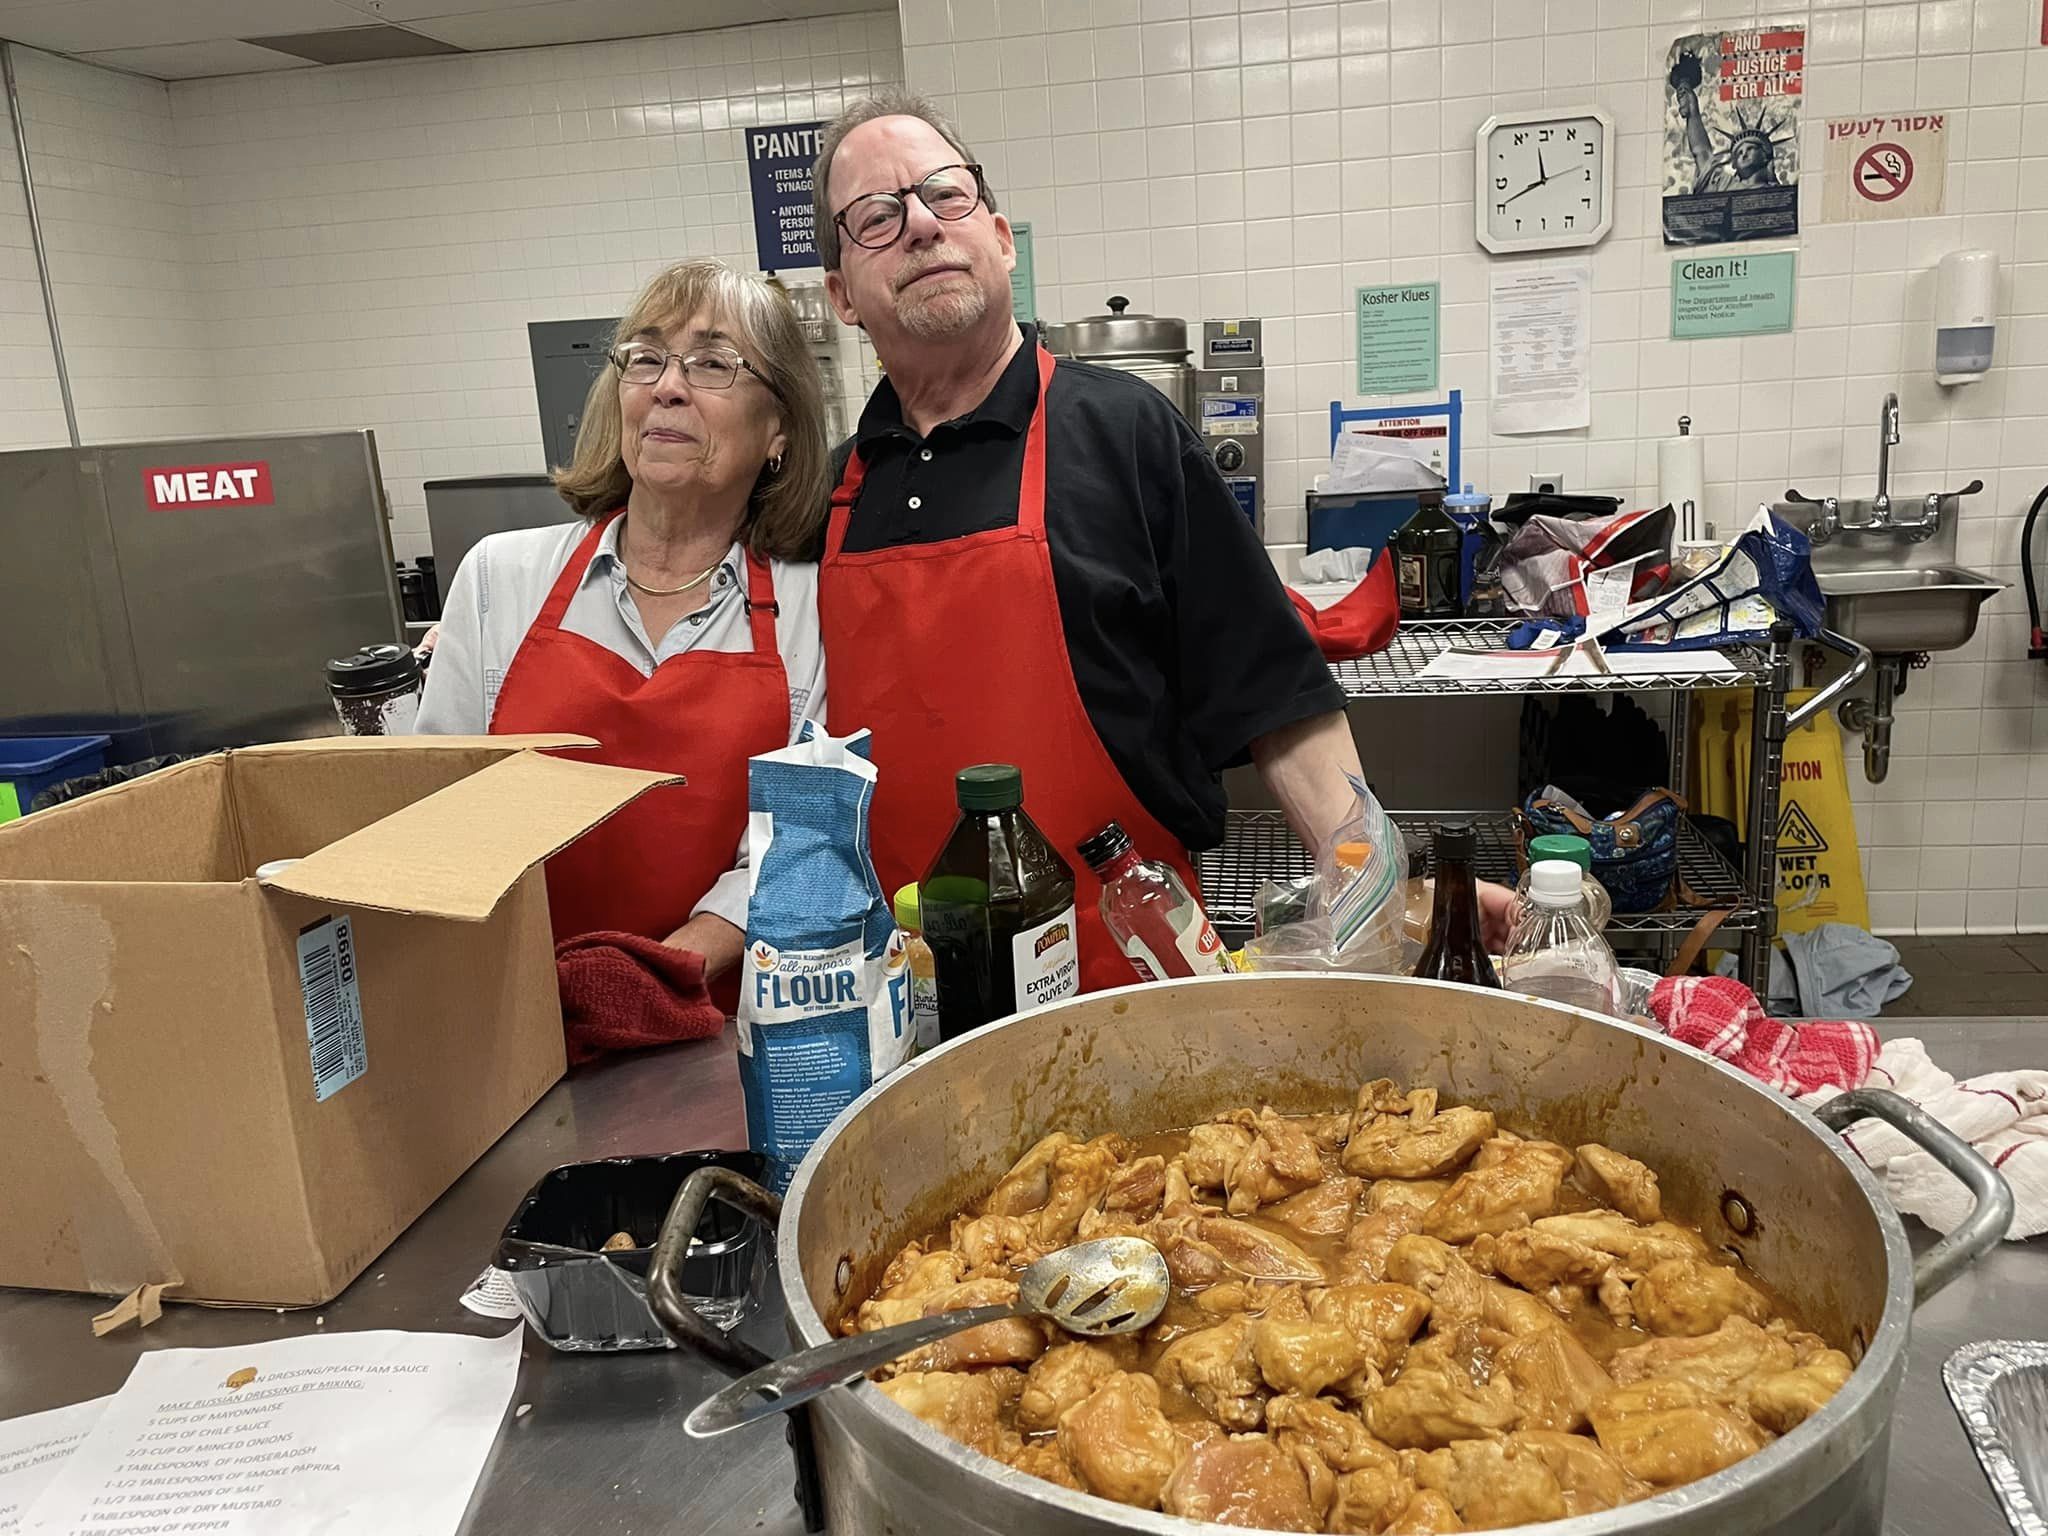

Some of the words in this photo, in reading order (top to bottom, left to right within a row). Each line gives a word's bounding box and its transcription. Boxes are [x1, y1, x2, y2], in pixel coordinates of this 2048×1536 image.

[1733, 56, 1787, 75] JUSTICE
[1733, 82, 1758, 99] FOR
[1566, 128, 1577, 141] א
[775, 168, 803, 180] ITEMS
[776, 180, 814, 193] SYNAGO
[779, 204, 816, 217] ANYONE
[781, 229, 815, 242] SUPPLY
[1682, 262, 1724, 280] Clean
[1730, 260, 1747, 277] It!
[1362, 291, 1399, 305] Kosher
[1401, 290, 1430, 302] Klues
[1378, 418, 1420, 427] ATTENTION
[153, 469, 258, 503] MEAT
[1780, 856, 1816, 871] WET
[779, 957, 853, 976] all-purpose
[1027, 974, 1055, 995] EXTRA
[1056, 959, 1076, 979] VIRGIN
[756, 970, 856, 1008] FLOUR
[1038, 984, 1062, 1004] OLIVE
[1062, 976, 1072, 990] OIL
[392, 1365, 430, 1374] SAUCE
[158, 1401, 192, 1411] MAKE
[192, 1394, 243, 1408] RUSSIAN
[245, 1384, 300, 1400] DRESSING
[302, 1383, 318, 1391] BY
[158, 1416, 188, 1425] CUPS
[189, 1414, 207, 1422] OF
[208, 1402, 285, 1421] MAYONNAISE
[147, 1432, 178, 1440] CUPS
[180, 1430, 197, 1439] OF
[199, 1426, 233, 1437] CHILE
[234, 1420, 272, 1432] SAUCE
[176, 1445, 195, 1454] OF
[195, 1440, 244, 1452] MINCED
[246, 1432, 294, 1447] ONIONS
[127, 1459, 210, 1472] TABLESPOONS
[214, 1457, 234, 1467] OF
[234, 1446, 318, 1464] HORSERADISH
[140, 1473, 224, 1487] TABLESPOONS
[225, 1471, 244, 1480] OF
[245, 1466, 289, 1479] SMOKE
[291, 1463, 341, 1474] PAPRIKA
[128, 1488, 213, 1503] TABLESPOONS
[215, 1486, 234, 1496] OF
[235, 1484, 264, 1494] SALT
[92, 1508, 171, 1521] TABLESPOON
[173, 1505, 192, 1514] OF
[192, 1503, 219, 1514] DRY
[220, 1499, 282, 1511] MUSTARD
[162, 1523, 181, 1532] OF
[182, 1519, 230, 1531] PEPPER
